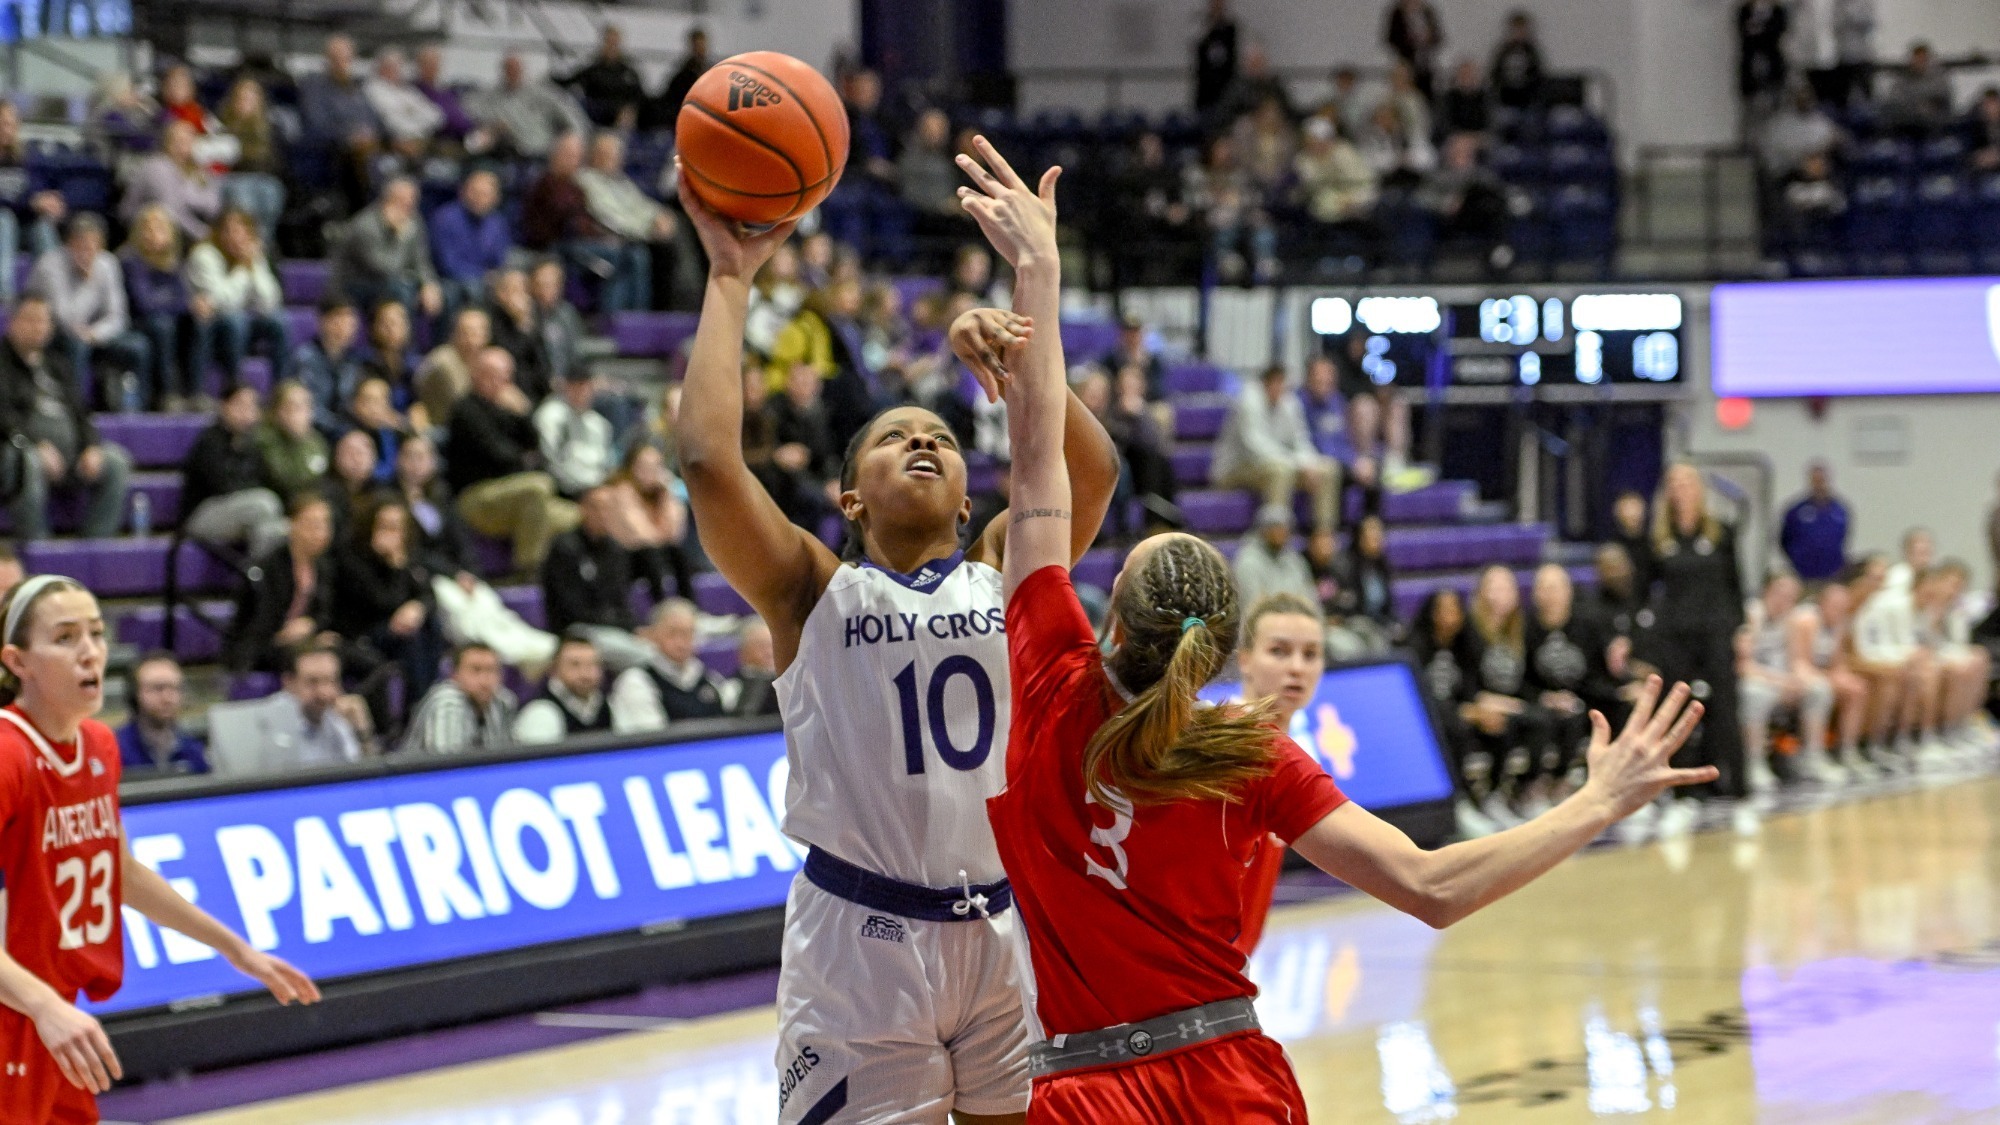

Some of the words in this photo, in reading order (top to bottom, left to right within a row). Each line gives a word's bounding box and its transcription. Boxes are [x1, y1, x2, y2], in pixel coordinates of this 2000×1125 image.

[729, 71, 782, 105] adidas
[845, 613, 918, 648] HOLY
[893, 654, 996, 776] 10
[214, 781, 622, 952] PATRIOT
[1083, 780, 1134, 890] 3
[55, 849, 113, 950] 23
